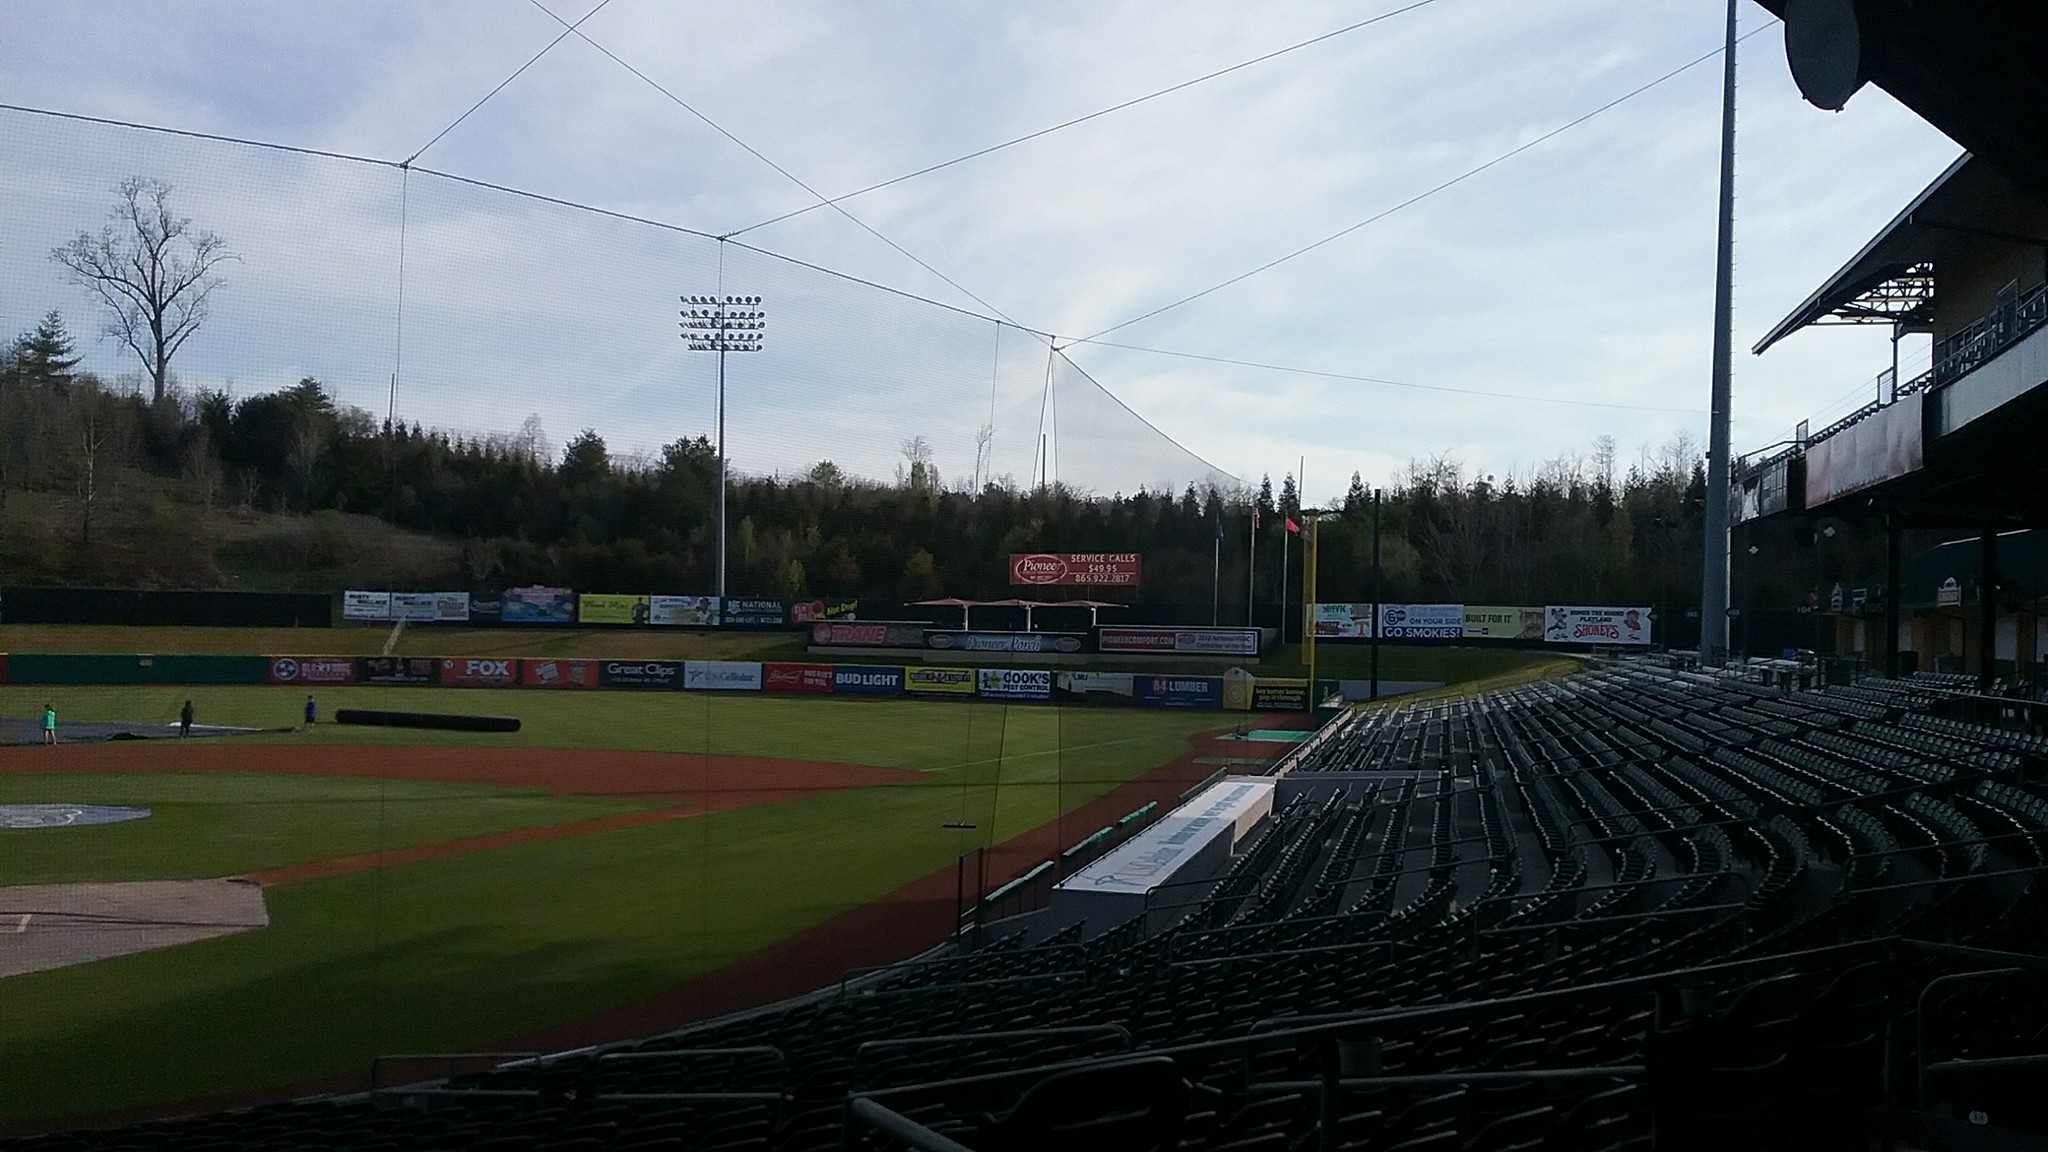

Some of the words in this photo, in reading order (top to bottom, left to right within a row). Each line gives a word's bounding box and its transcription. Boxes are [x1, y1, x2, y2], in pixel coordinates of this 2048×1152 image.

[1071, 554, 1105, 563] SERVICE
[1109, 554, 1136, 563] CALLS
[1088, 564, 1117, 573] $49.95
[742, 601, 781, 609] NATIONAL
[1465, 614, 1486, 623] BUILT
[1488, 614, 1503, 623] FOR
[831, 625, 887, 644] TRANE
[1385, 627, 1403, 637] GO
[1406, 627, 1460, 638] SMOKIES!
[465, 659, 510, 676] FOX
[607, 662, 644, 676] Great
[645, 663, 675, 677] Clips
[835, 672, 862, 685] BUD
[863, 674, 899, 686] LIGHT
[1003, 672, 1049, 684] COOK'S
[1019, 684, 1049, 692] CONTROL
[1152, 680, 1167, 692] 84
[1169, 681, 1208, 693] LUMBER
